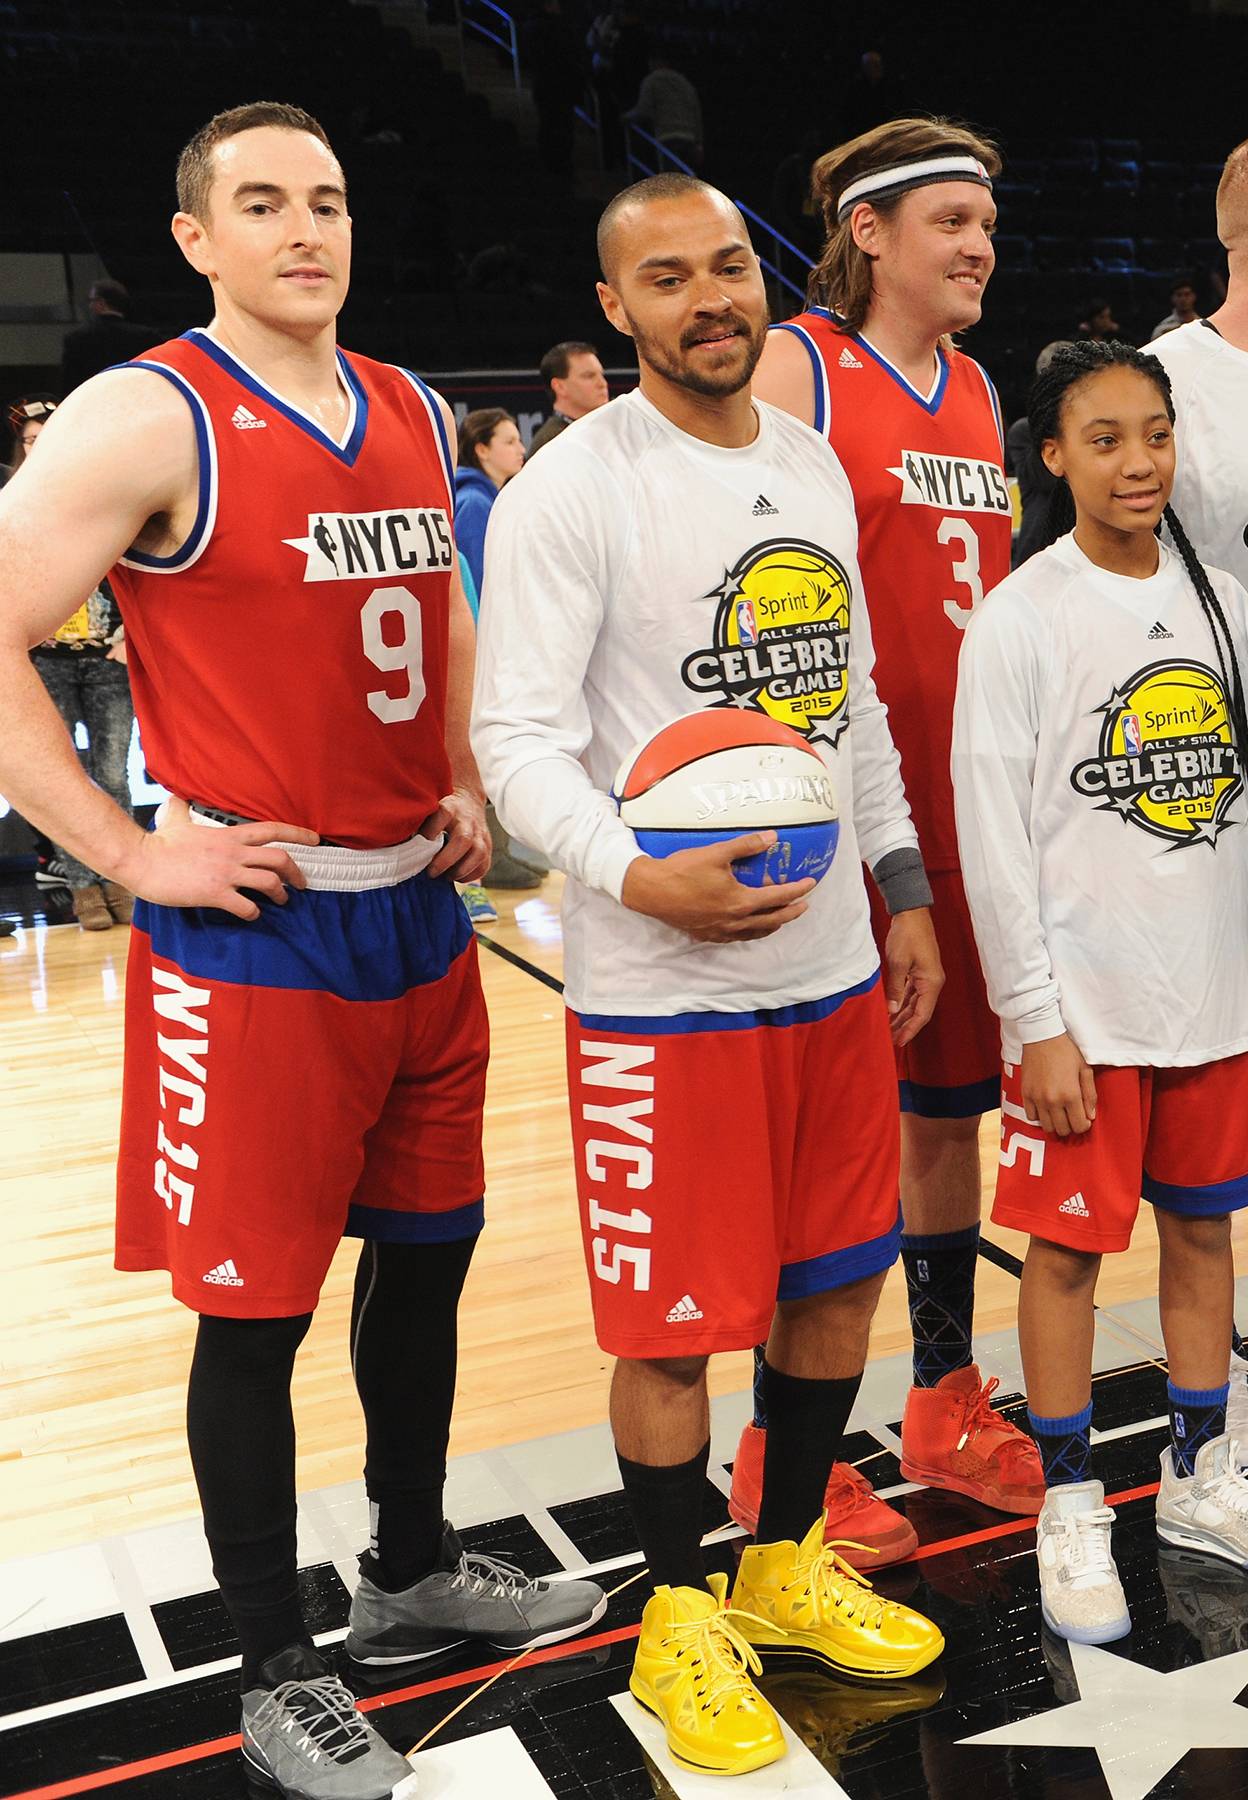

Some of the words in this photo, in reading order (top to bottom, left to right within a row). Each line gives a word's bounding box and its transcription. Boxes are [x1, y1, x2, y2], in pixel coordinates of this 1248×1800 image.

[920, 457, 975, 507] NYC
[977, 464, 1009, 510] 15
[752, 506, 779, 516] adidas
[337, 514, 417, 573] NYC
[418, 513, 452, 567] 15
[937, 516, 985, 630] 3
[759, 592, 809, 620] Sprint
[760, 628, 793, 641] ALL
[802, 621, 840, 634] STAR
[1147, 632, 1174, 640] adidas
[361, 586, 426, 724] 9
[687, 633, 850, 687] CELEBRI
[768, 670, 842, 698] GAME
[790, 696, 832, 713] 2015
[1145, 705, 1198, 731] Sprint
[1143, 739, 1175, 751] ALL
[1190, 735, 1218, 745] STAR
[1075, 747, 1241, 792] CELEBRIT
[691, 775, 834, 821] SPALDING
[1149, 778, 1215, 801] GAME
[1168, 803, 1212, 816] 2015
[152, 966, 211, 1127] NYC
[579, 1039, 655, 1190] NYC
[154, 1120, 199, 1226] 15
[1058, 1203, 1089, 1218] adidas
[589, 1199, 652, 1291] 15
[202, 1271, 244, 1287] adidas
[666, 1308, 703, 1323] adidas
